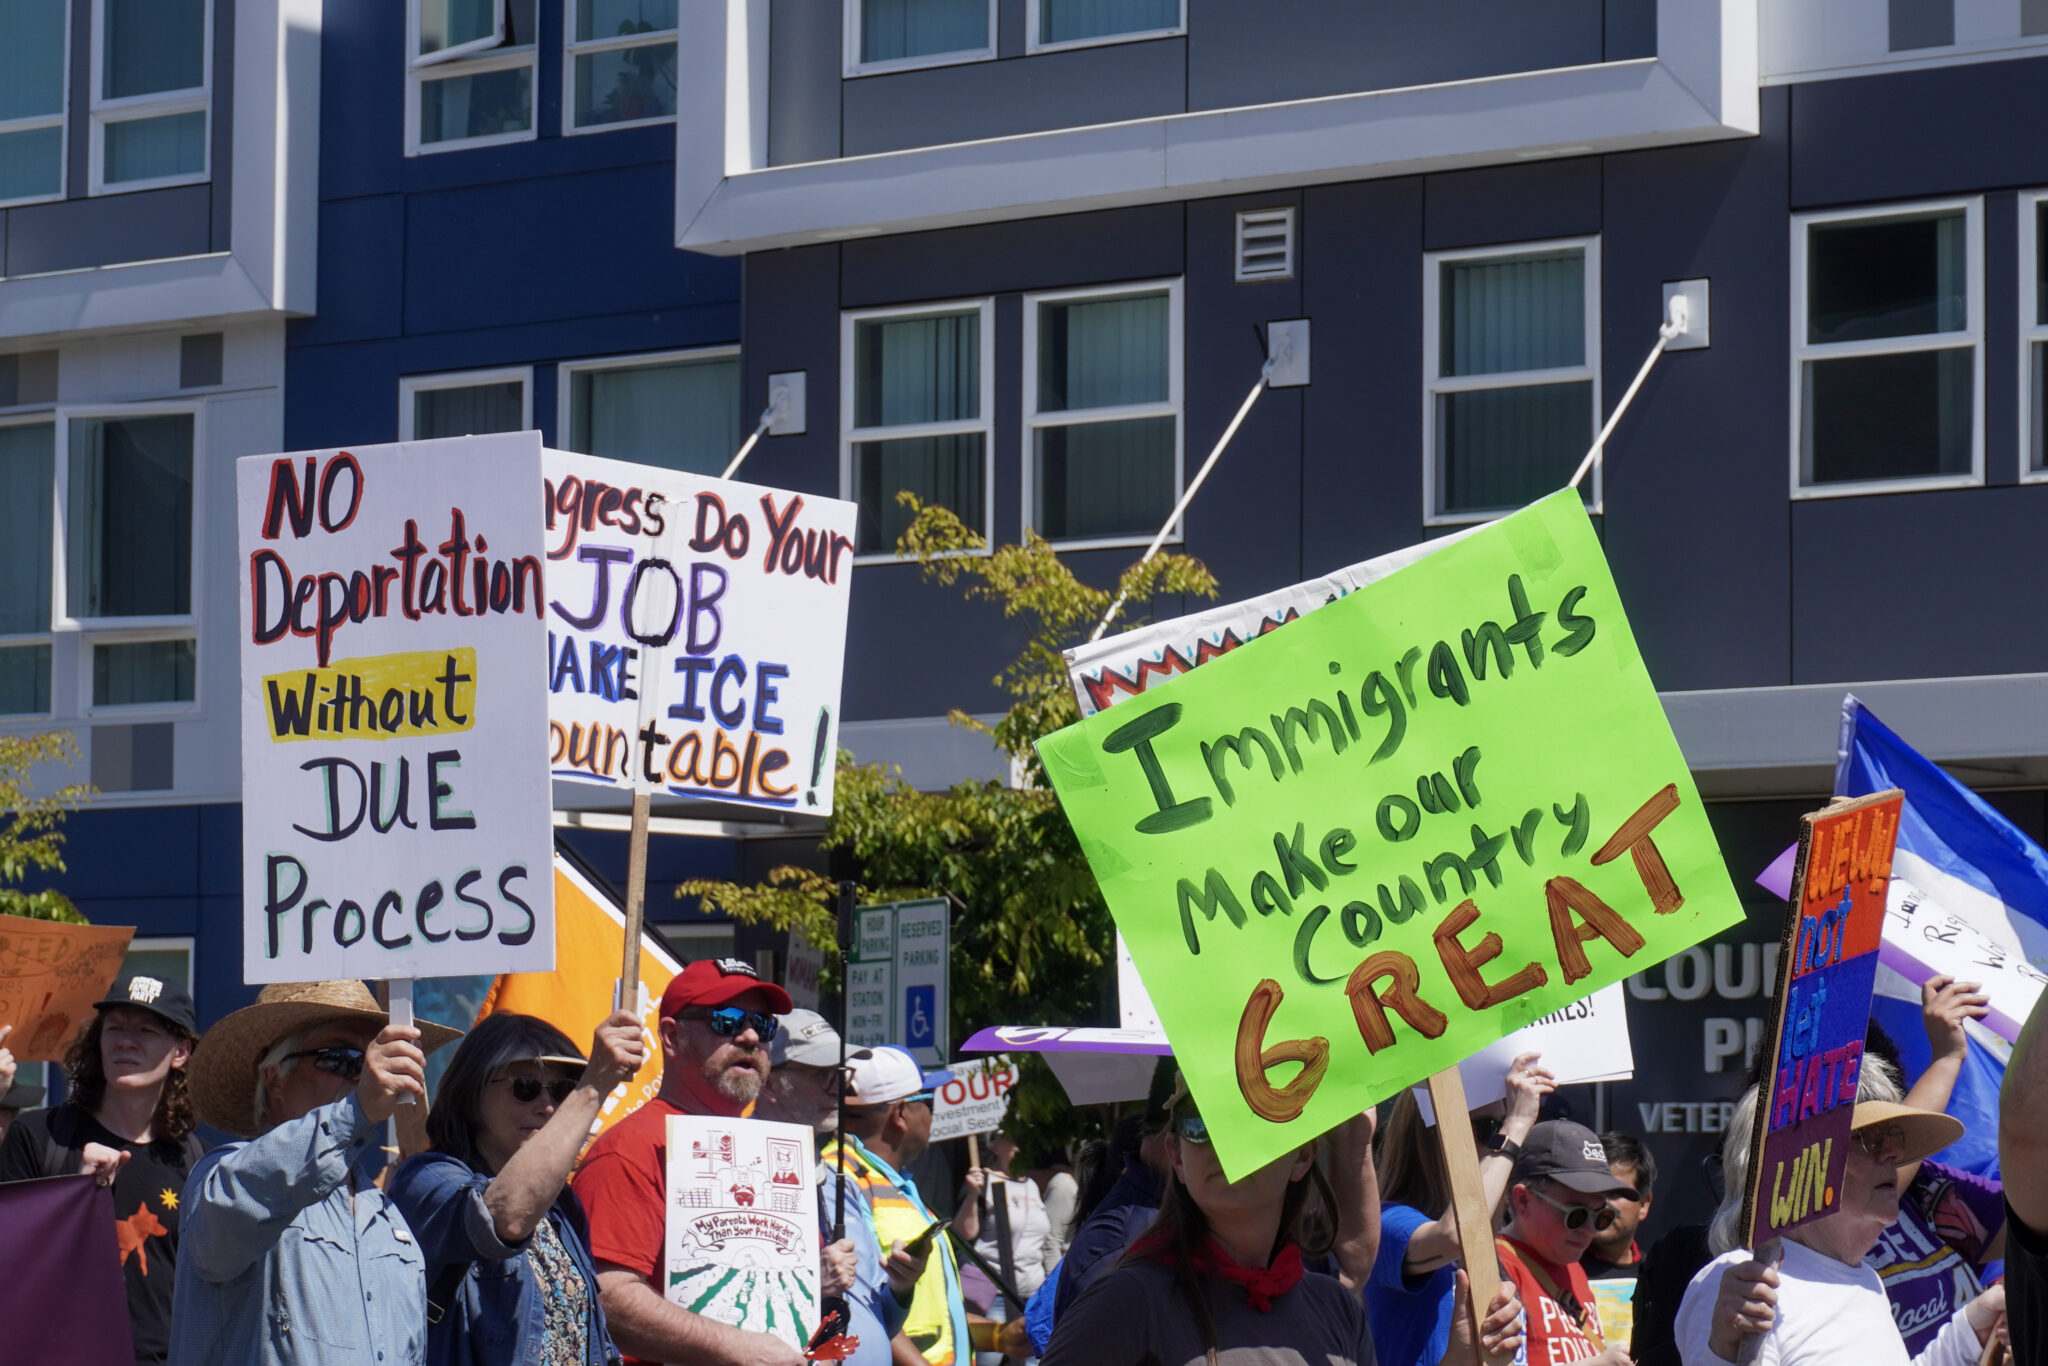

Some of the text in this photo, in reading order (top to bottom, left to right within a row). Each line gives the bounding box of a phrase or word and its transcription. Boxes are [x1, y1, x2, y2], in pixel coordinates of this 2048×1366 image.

[262, 451, 364, 540] NO
[688, 491, 750, 559] Do
[759, 492, 854, 585] Your
[251, 507, 543, 667] Deportation
[550, 543, 730, 656] JOB
[268, 655, 471, 735] Without
[668, 654, 790, 735] ICE
[1103, 574, 1596, 834] Immigrants
[293, 749, 477, 841] DUE
[1176, 746, 1481, 955] Make our
[1293, 792, 1591, 984] Country
[264, 850, 536, 959] Process
[901, 919, 942, 939] RESERVED
[1795, 884, 1853, 976] not
[852, 967, 884, 985] PAY AT
[903, 949, 939, 967] PARKING
[1235, 783, 1685, 1123] GREAT
[852, 991, 884, 1008] STATION
[1783, 976, 1827, 1066] let
[942, 1070, 1013, 1106] OUR
[1774, 1040, 1863, 1129] HATE
[695, 1214, 794, 1238] My Parents Work Harder
[1769, 1138, 1834, 1230] WIN.
[708, 1225, 790, 1246] Than Your President
